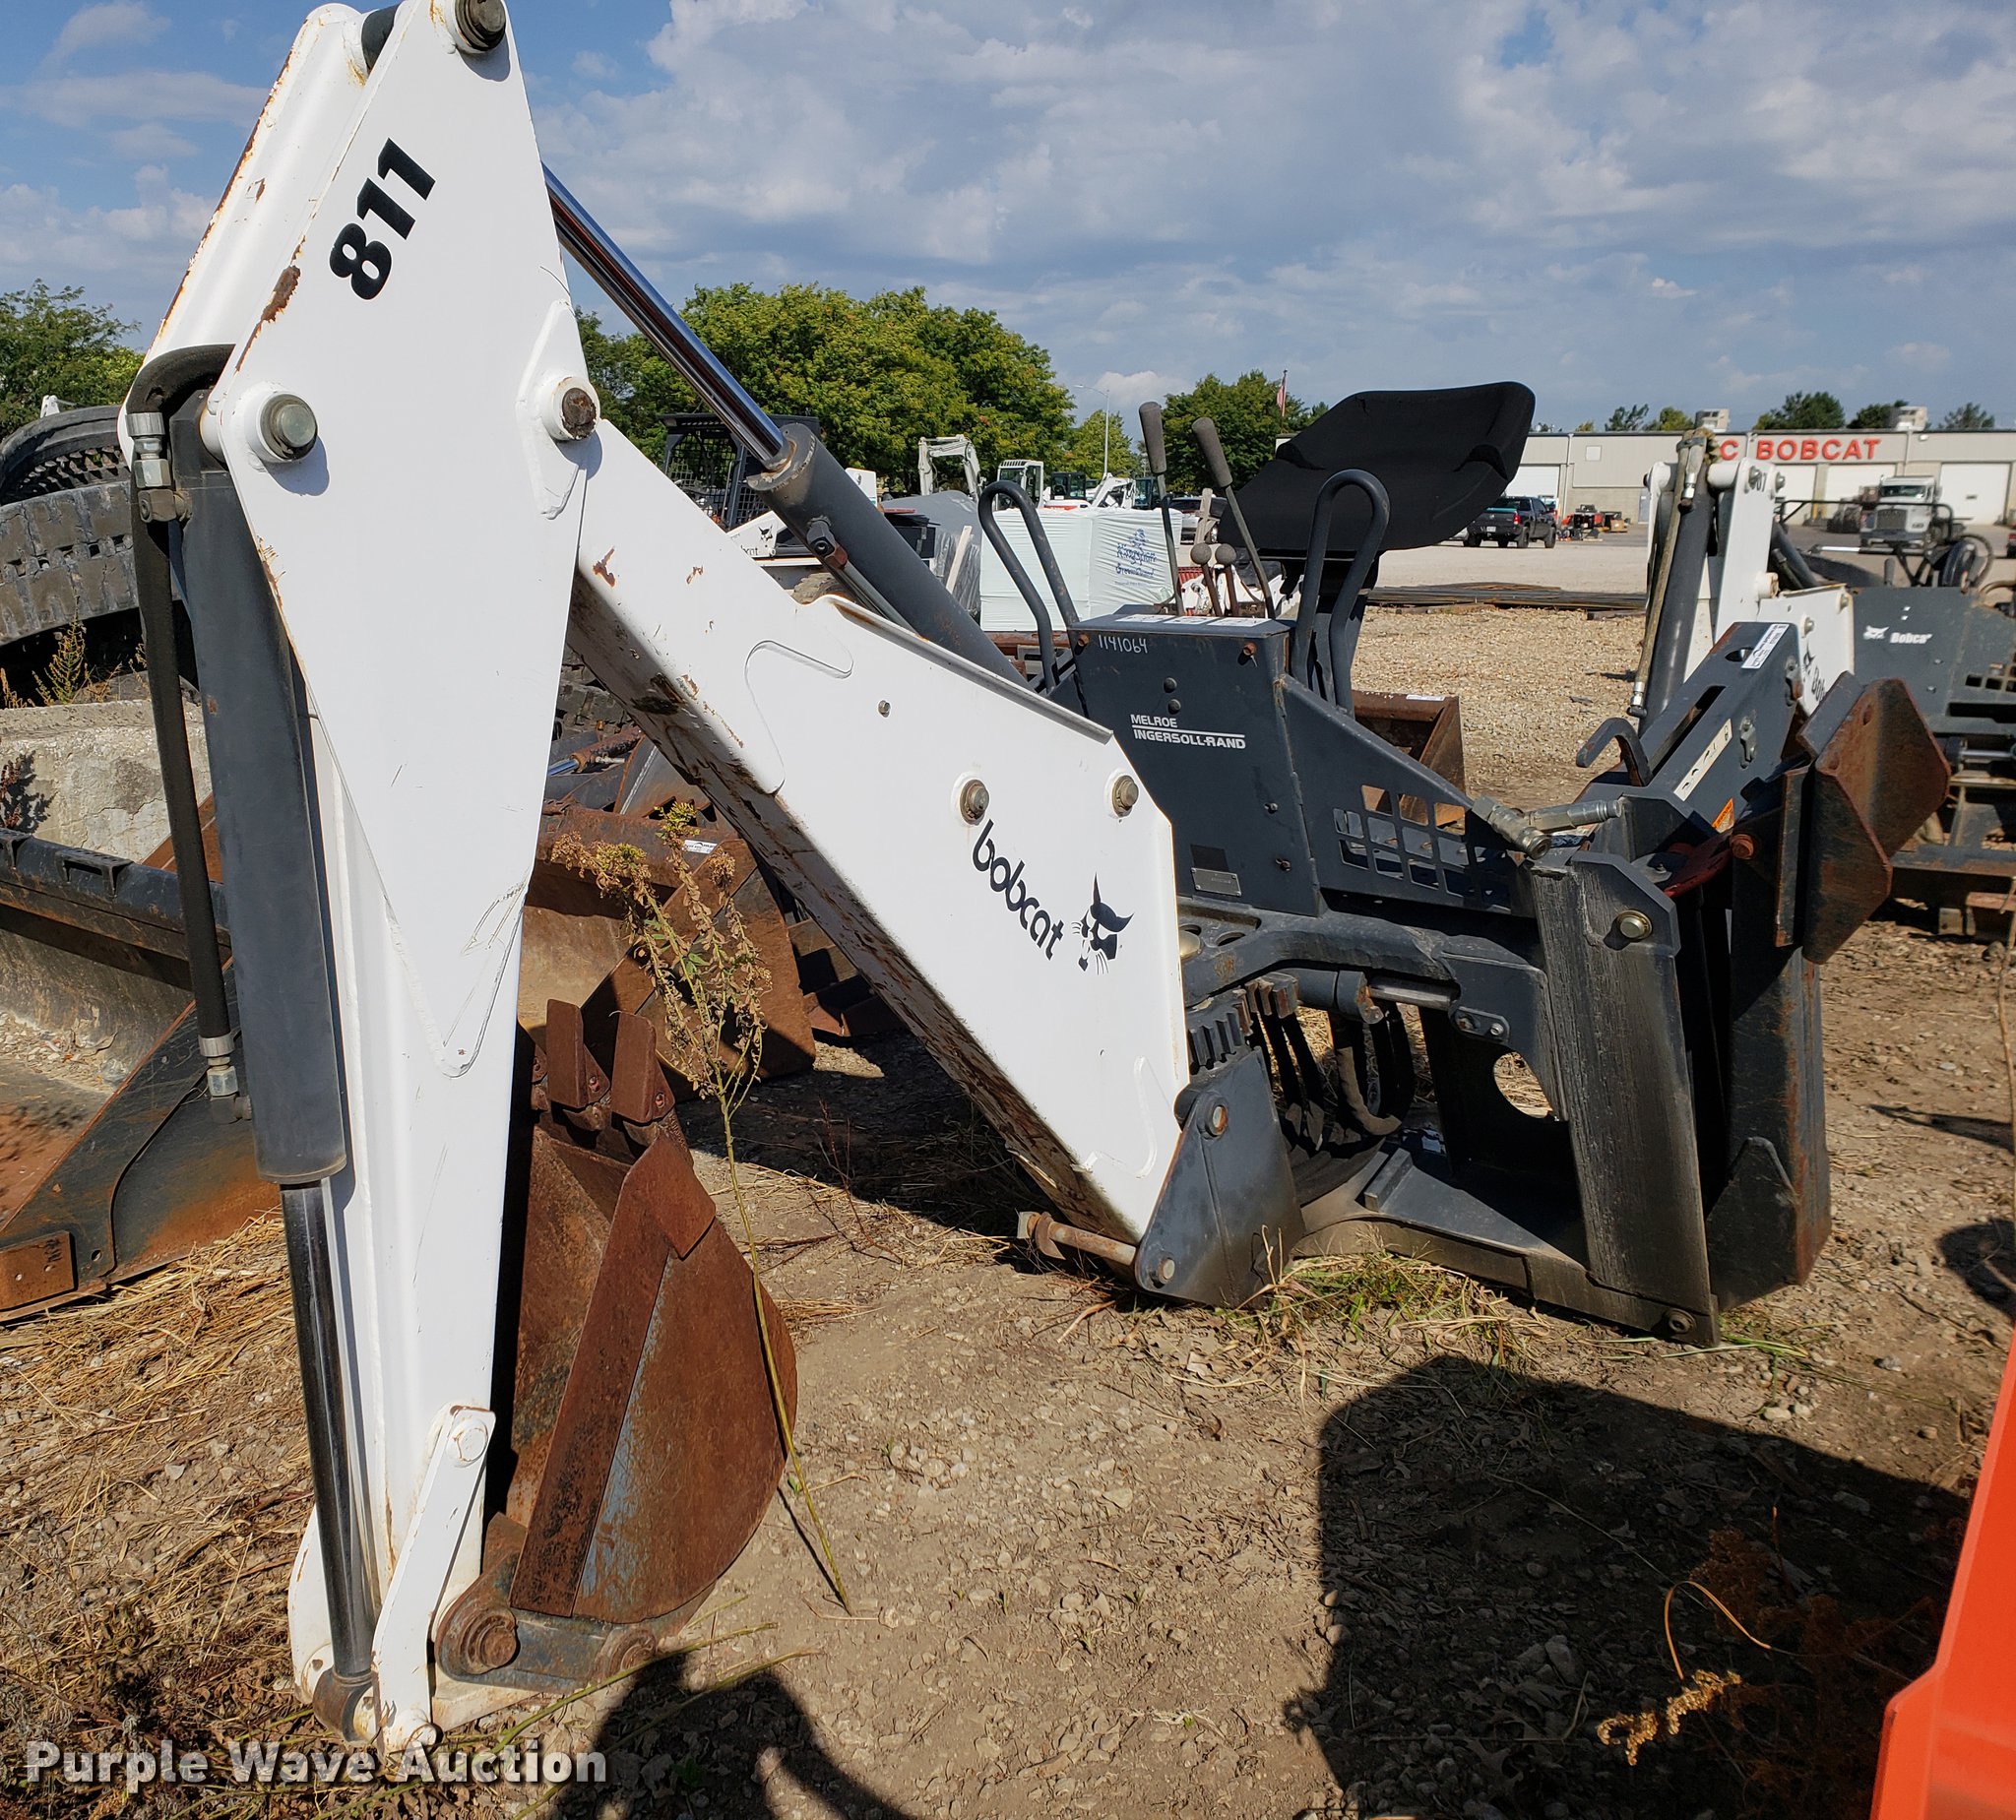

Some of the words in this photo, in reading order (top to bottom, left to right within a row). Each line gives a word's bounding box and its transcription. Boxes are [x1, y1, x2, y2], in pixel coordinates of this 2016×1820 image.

[329, 137, 436, 301] 811
[1755, 438, 1882, 462] BOBCAT
[1098, 634, 1149, 654] 1141064
[1130, 714, 1178, 728] MELROE
[1133, 728, 1246, 749] INGERSOLL-RAND
[972, 818, 1065, 962] bobcat
